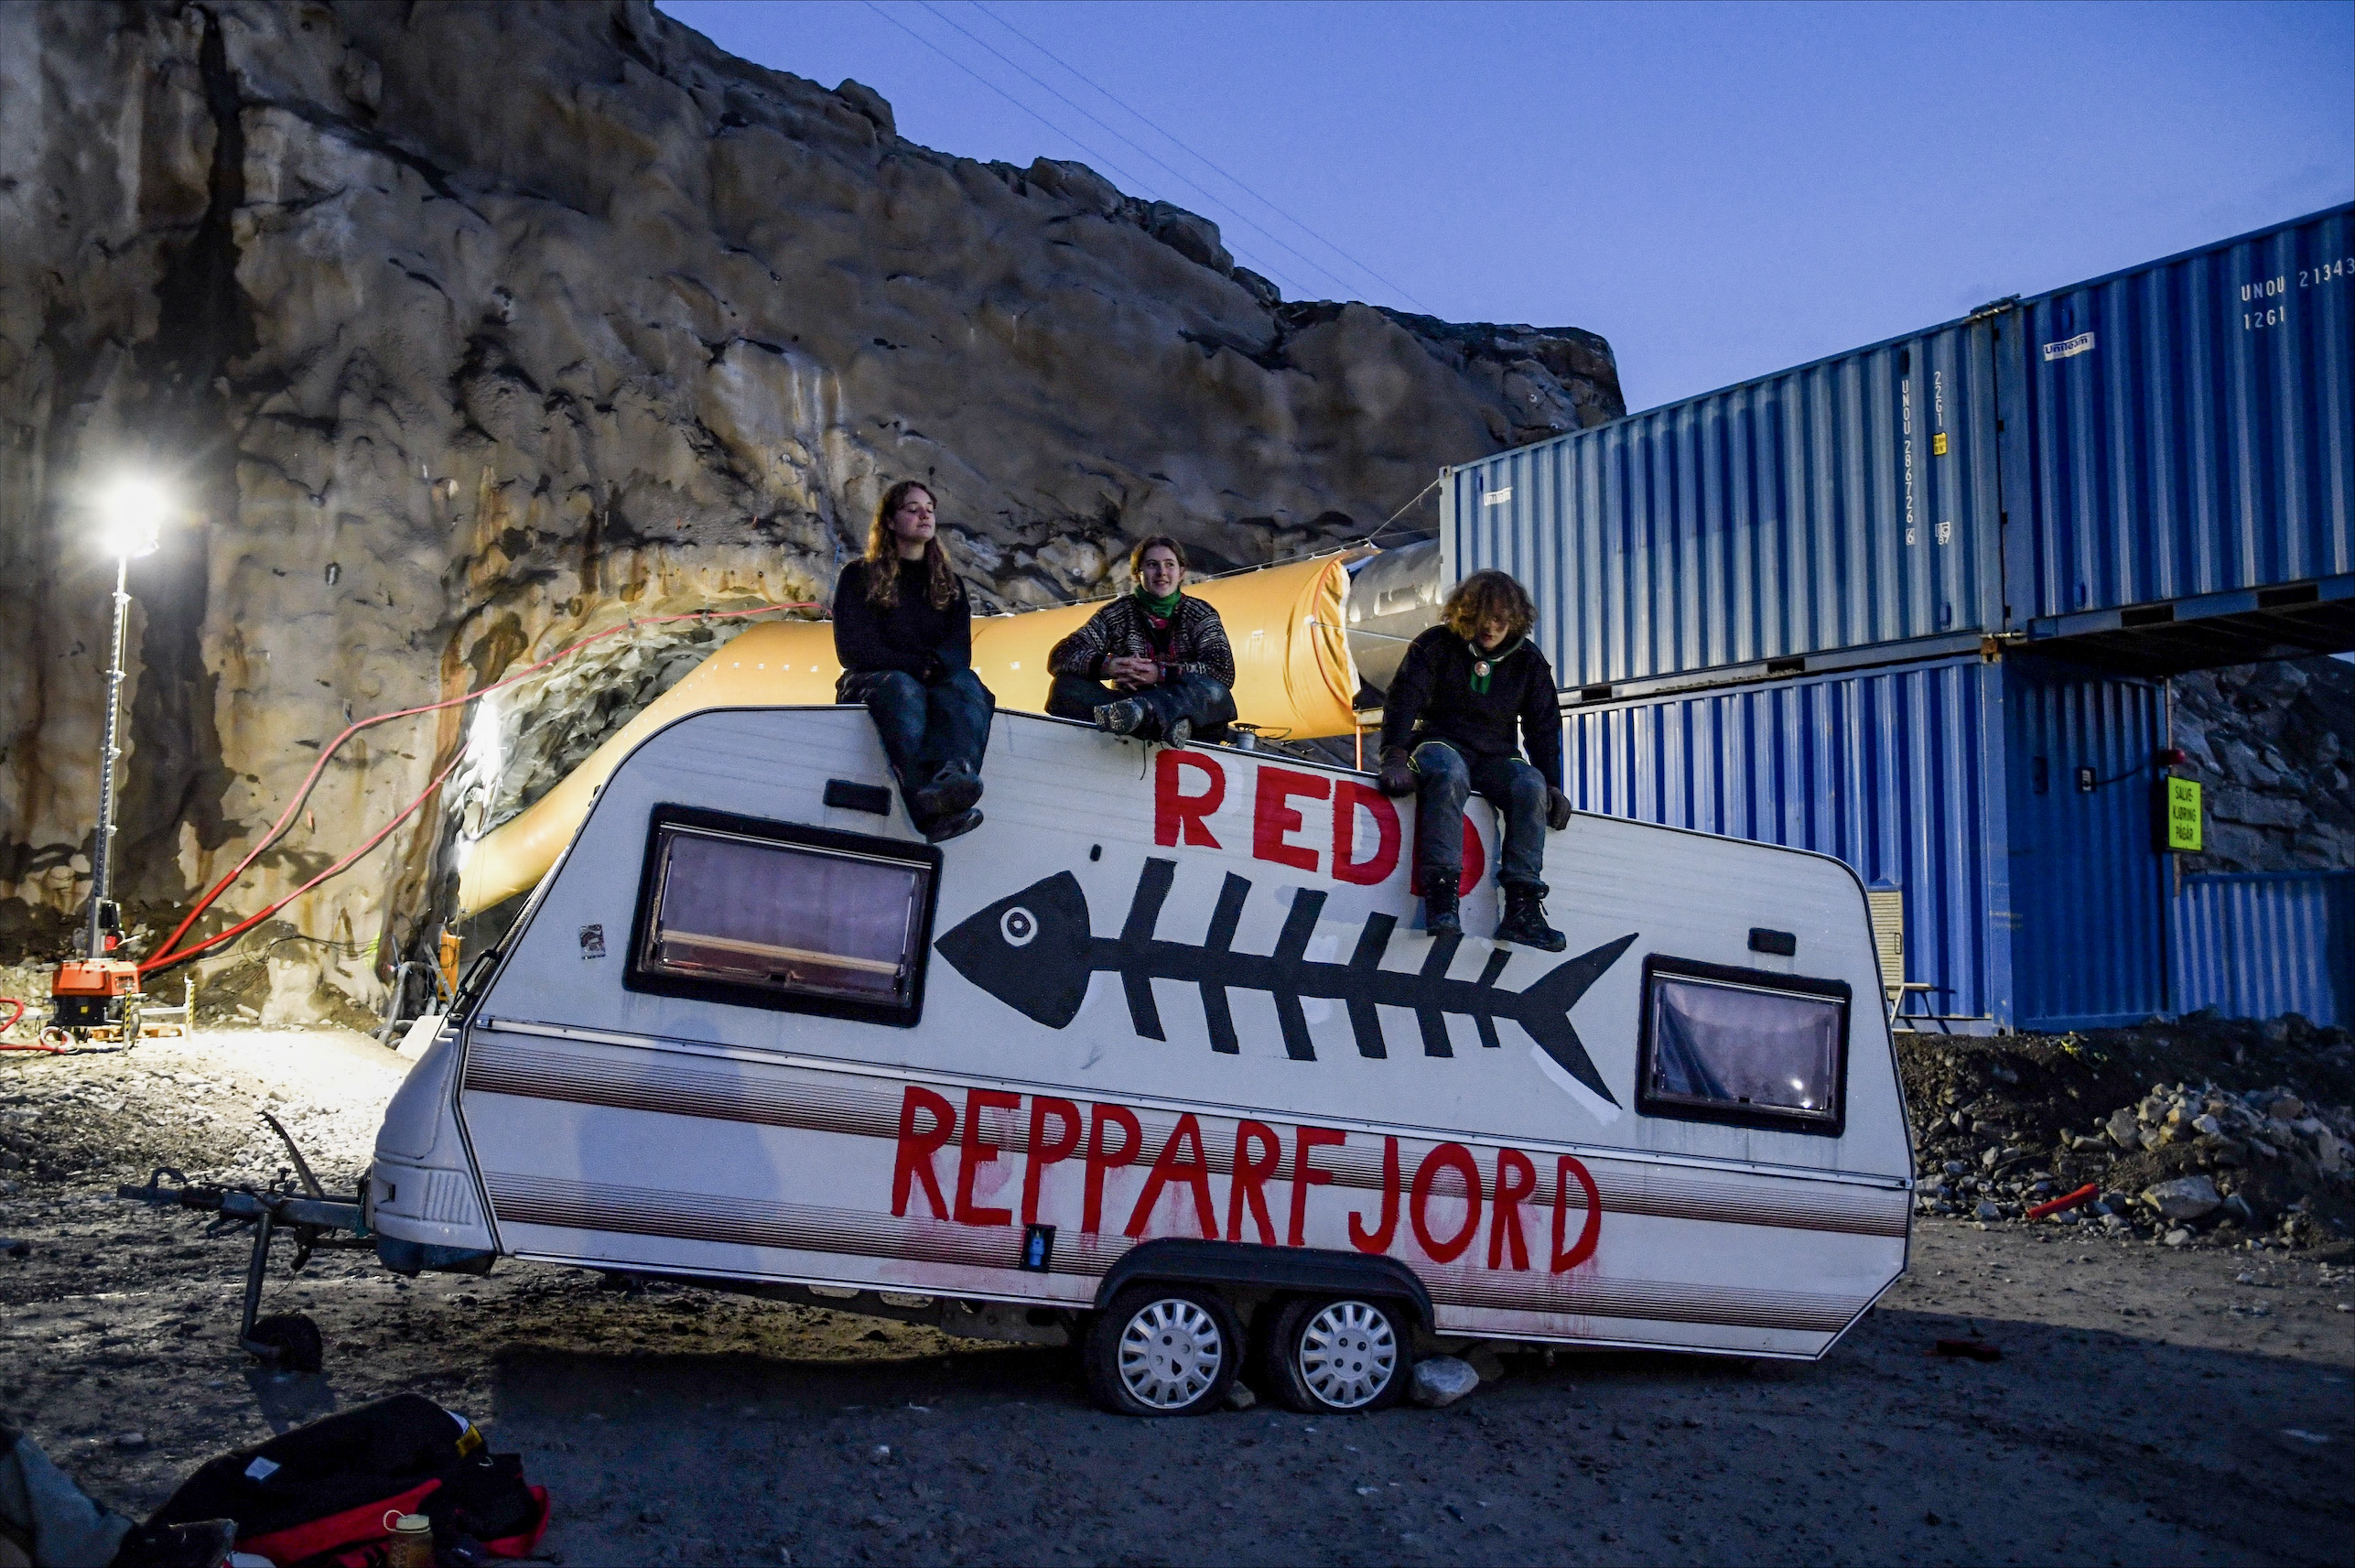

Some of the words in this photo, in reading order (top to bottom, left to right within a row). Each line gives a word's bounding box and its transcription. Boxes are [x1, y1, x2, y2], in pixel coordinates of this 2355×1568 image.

[2241, 276, 2285, 301] UNOU
[2298, 257, 2355, 287] 21343
[2243, 306, 2285, 330] 12G1
[1901, 379, 1911, 435] UNOU
[1934, 371, 1942, 427] 22G1
[1904, 439, 1914, 523] 286726
[891, 1086, 1601, 1274] REPPARFJORD
